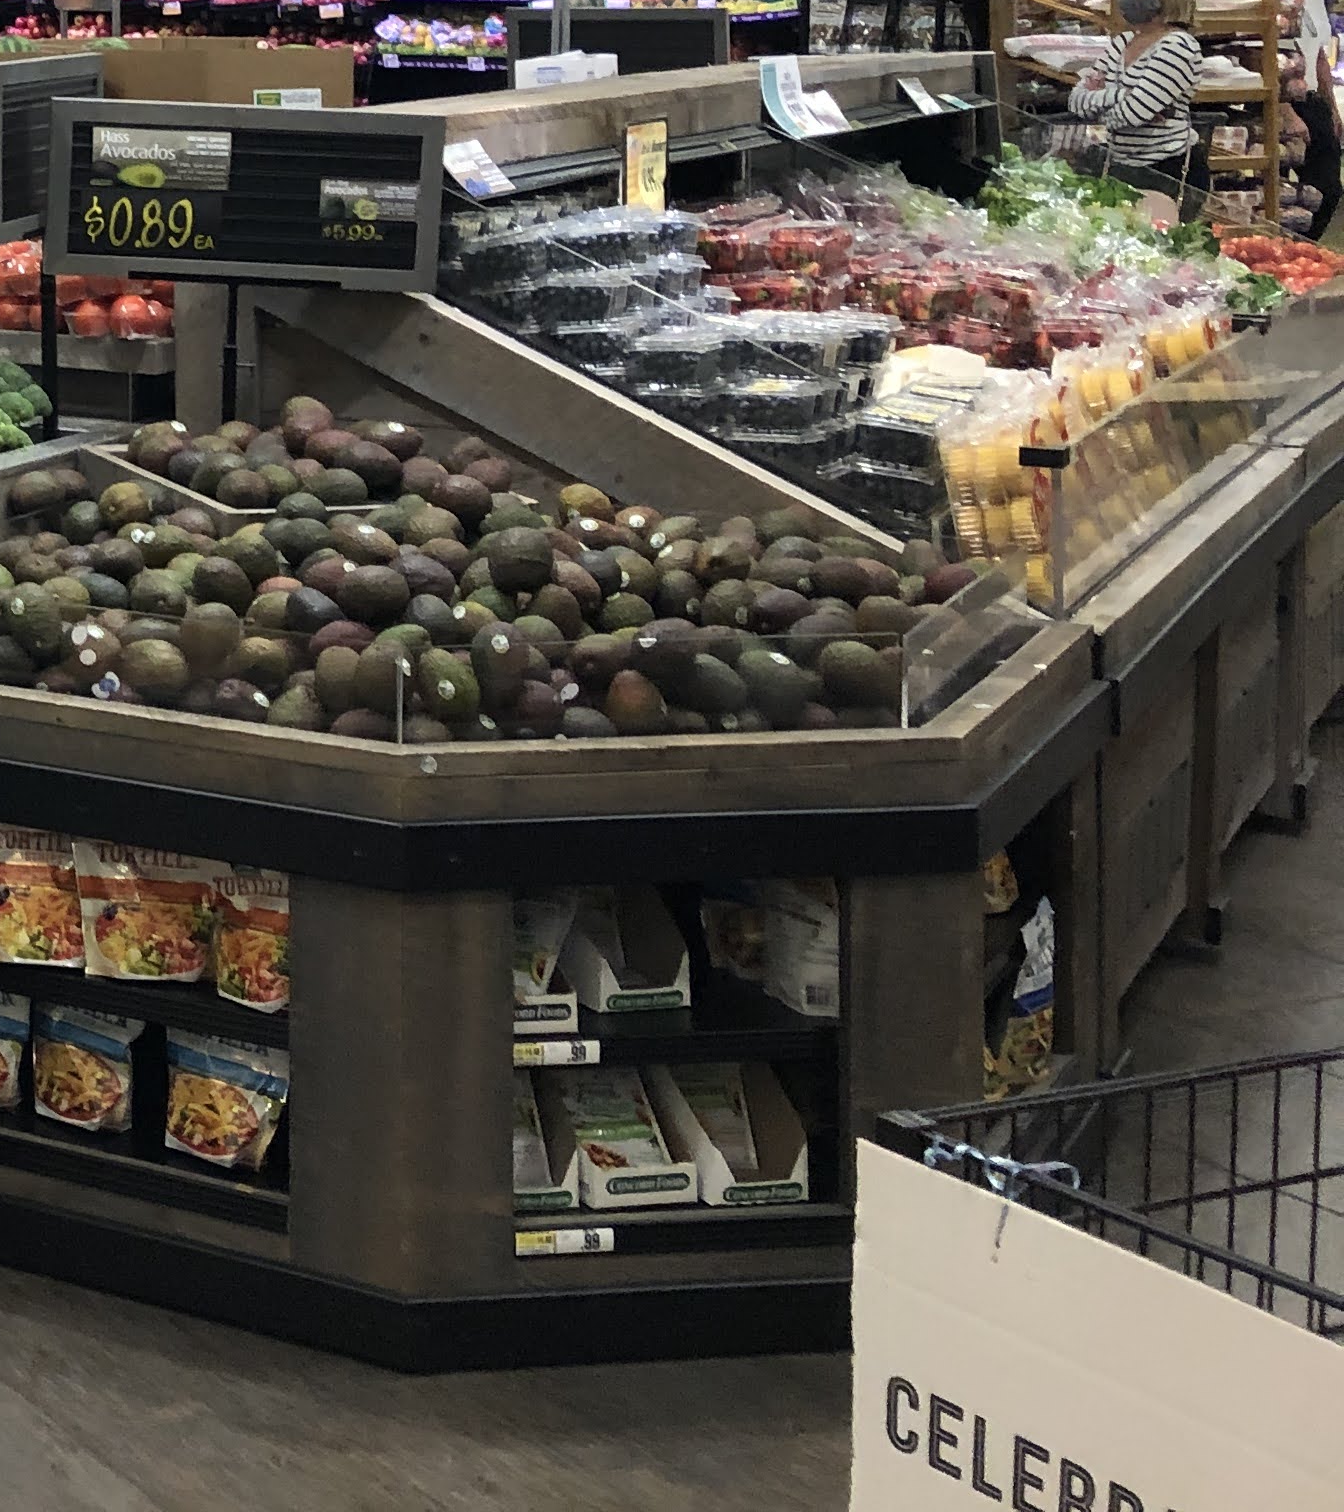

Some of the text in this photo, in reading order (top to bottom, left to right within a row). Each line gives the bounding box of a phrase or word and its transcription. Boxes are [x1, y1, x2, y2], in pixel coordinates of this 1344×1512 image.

[100, 130, 130, 144] Hass
[100, 143, 177, 161] Avocados
[84, 196, 215, 250] $0.89 EA
